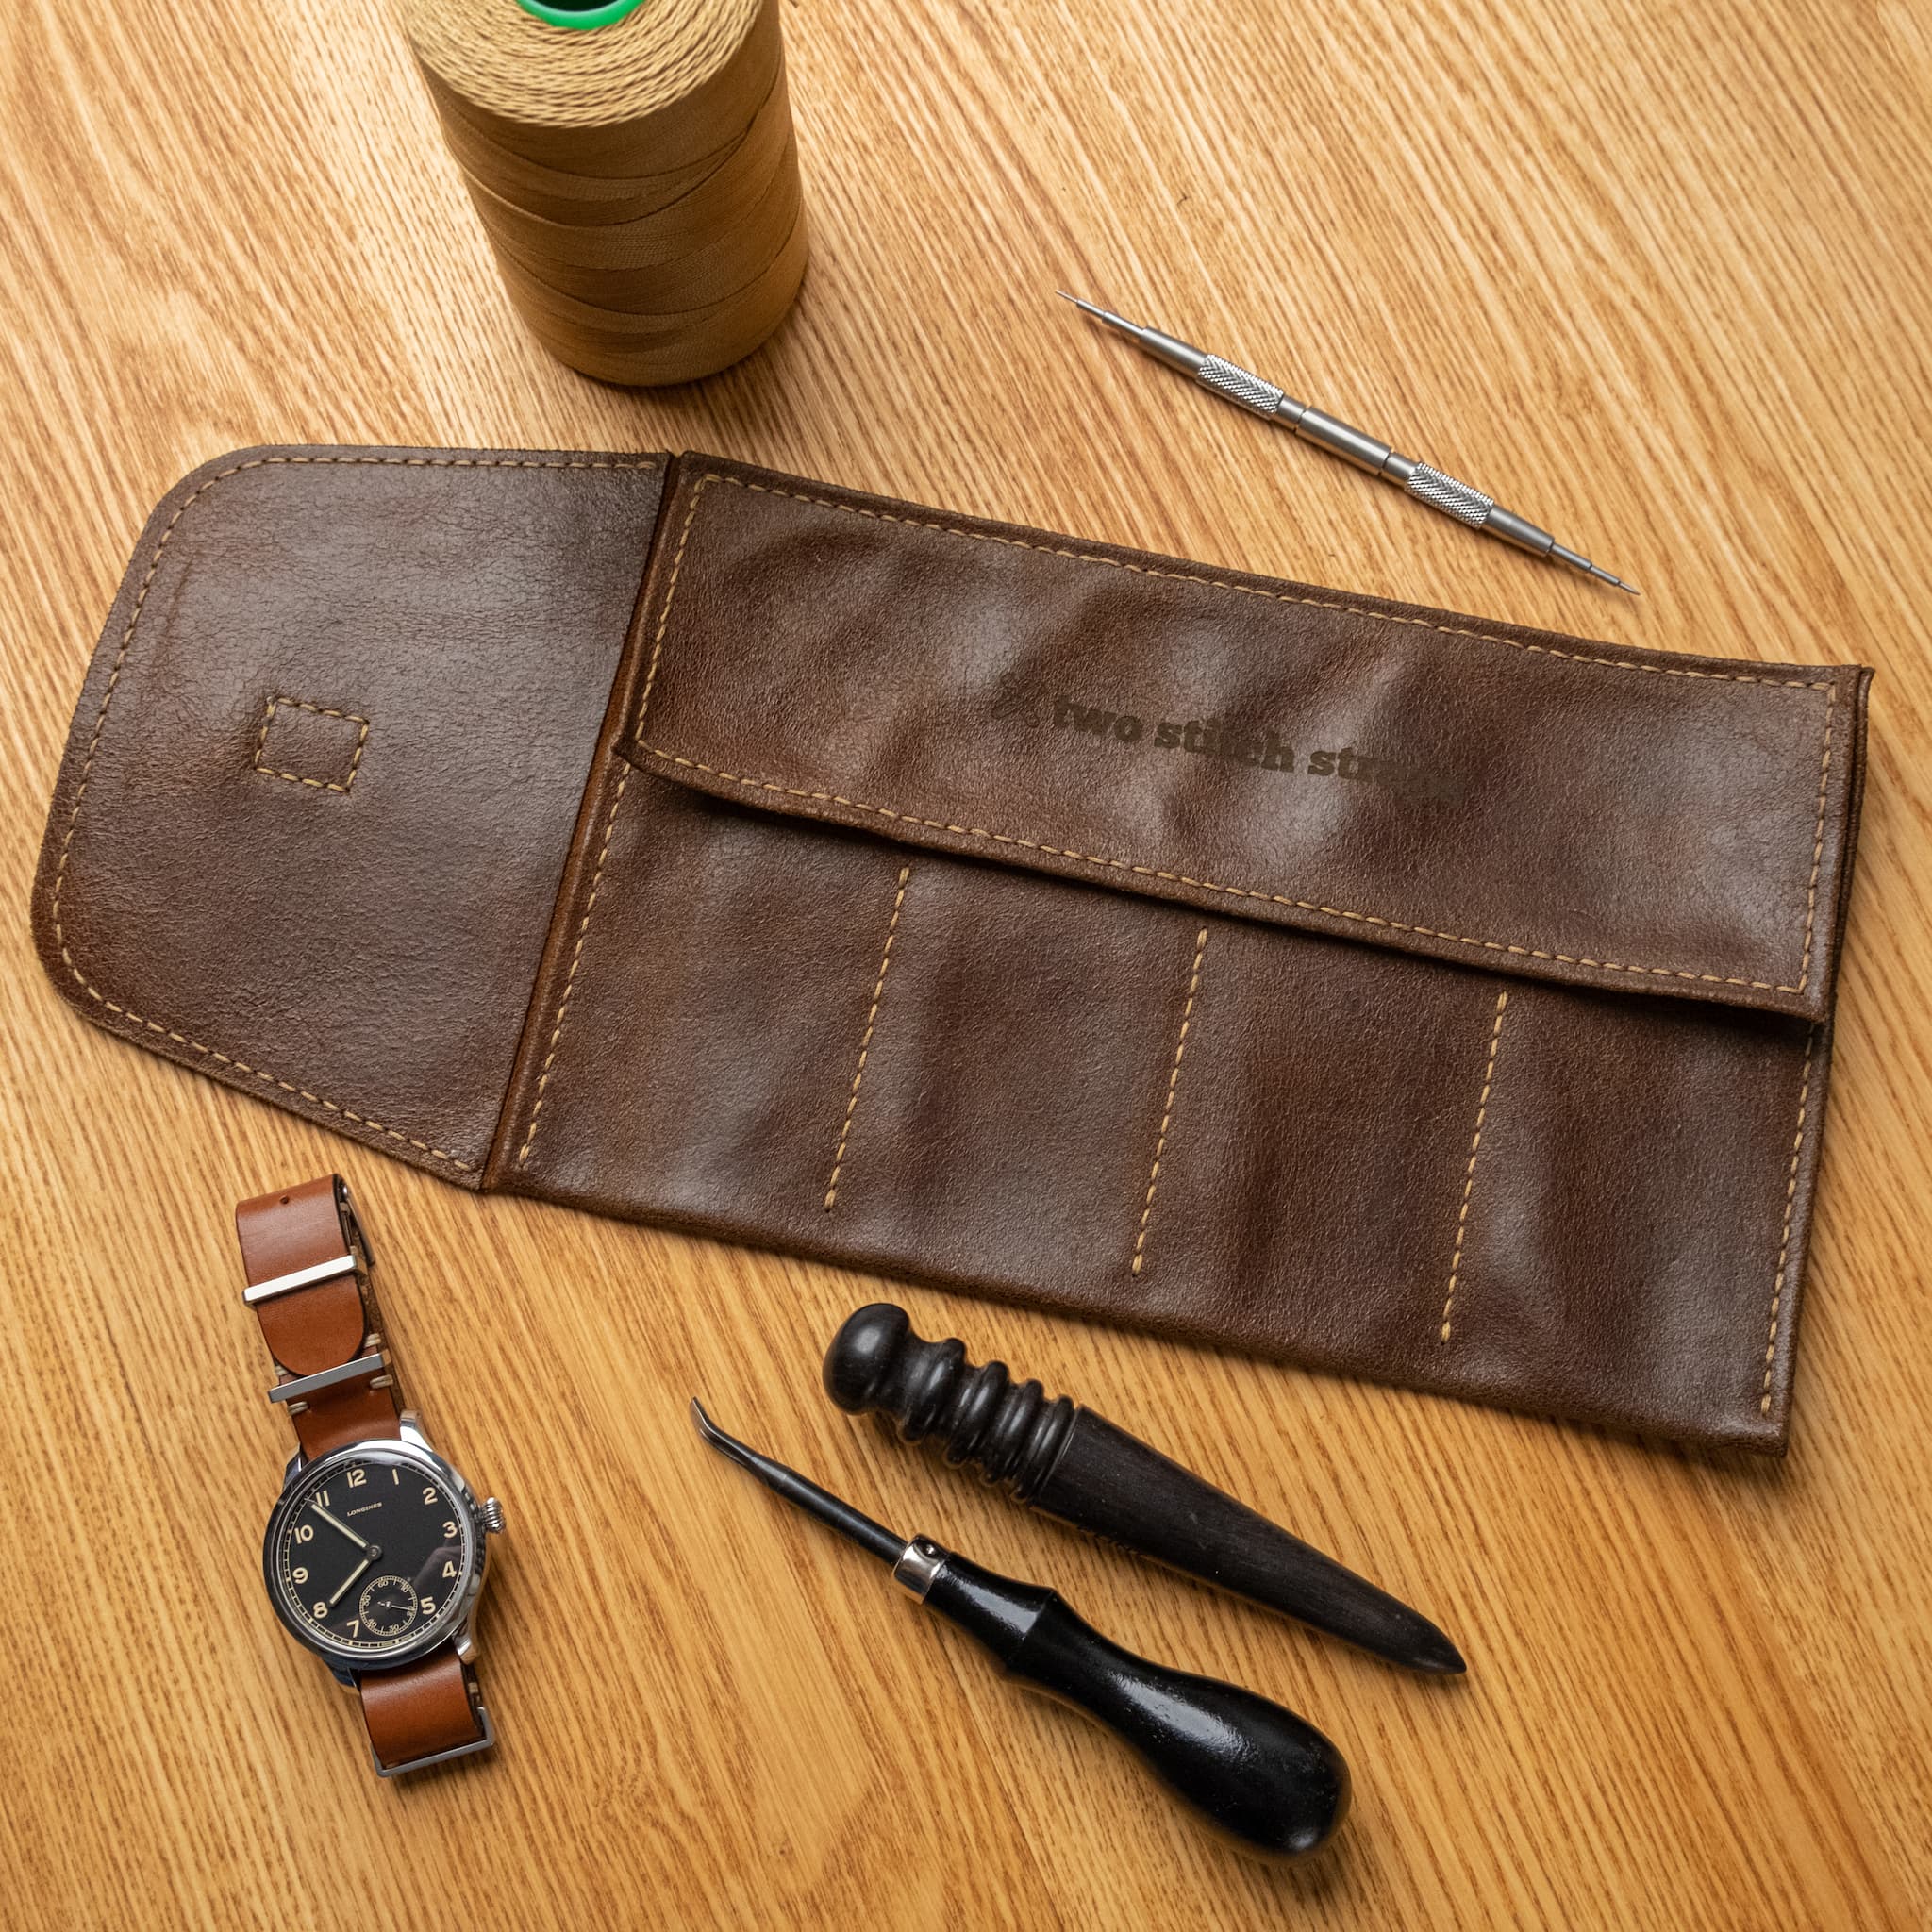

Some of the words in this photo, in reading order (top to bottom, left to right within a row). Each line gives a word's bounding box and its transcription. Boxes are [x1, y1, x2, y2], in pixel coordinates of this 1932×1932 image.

[1053, 694, 1143, 743] two
[347, 1469, 367, 1488] 12
[391, 1469, 400, 1486] 1
[315, 1490, 330, 1508] 11
[422, 1487, 438, 1505] 2
[346, 1502, 383, 1517] LONGINES
[293, 1524, 314, 1544] 10
[442, 1521, 458, 1539] 3
[292, 1567, 309, 1585] 9
[441, 1561, 457, 1580] 4
[312, 1602, 328, 1619] 8
[420, 1596, 436, 1615] 5
[346, 1619, 360, 1639] 7
